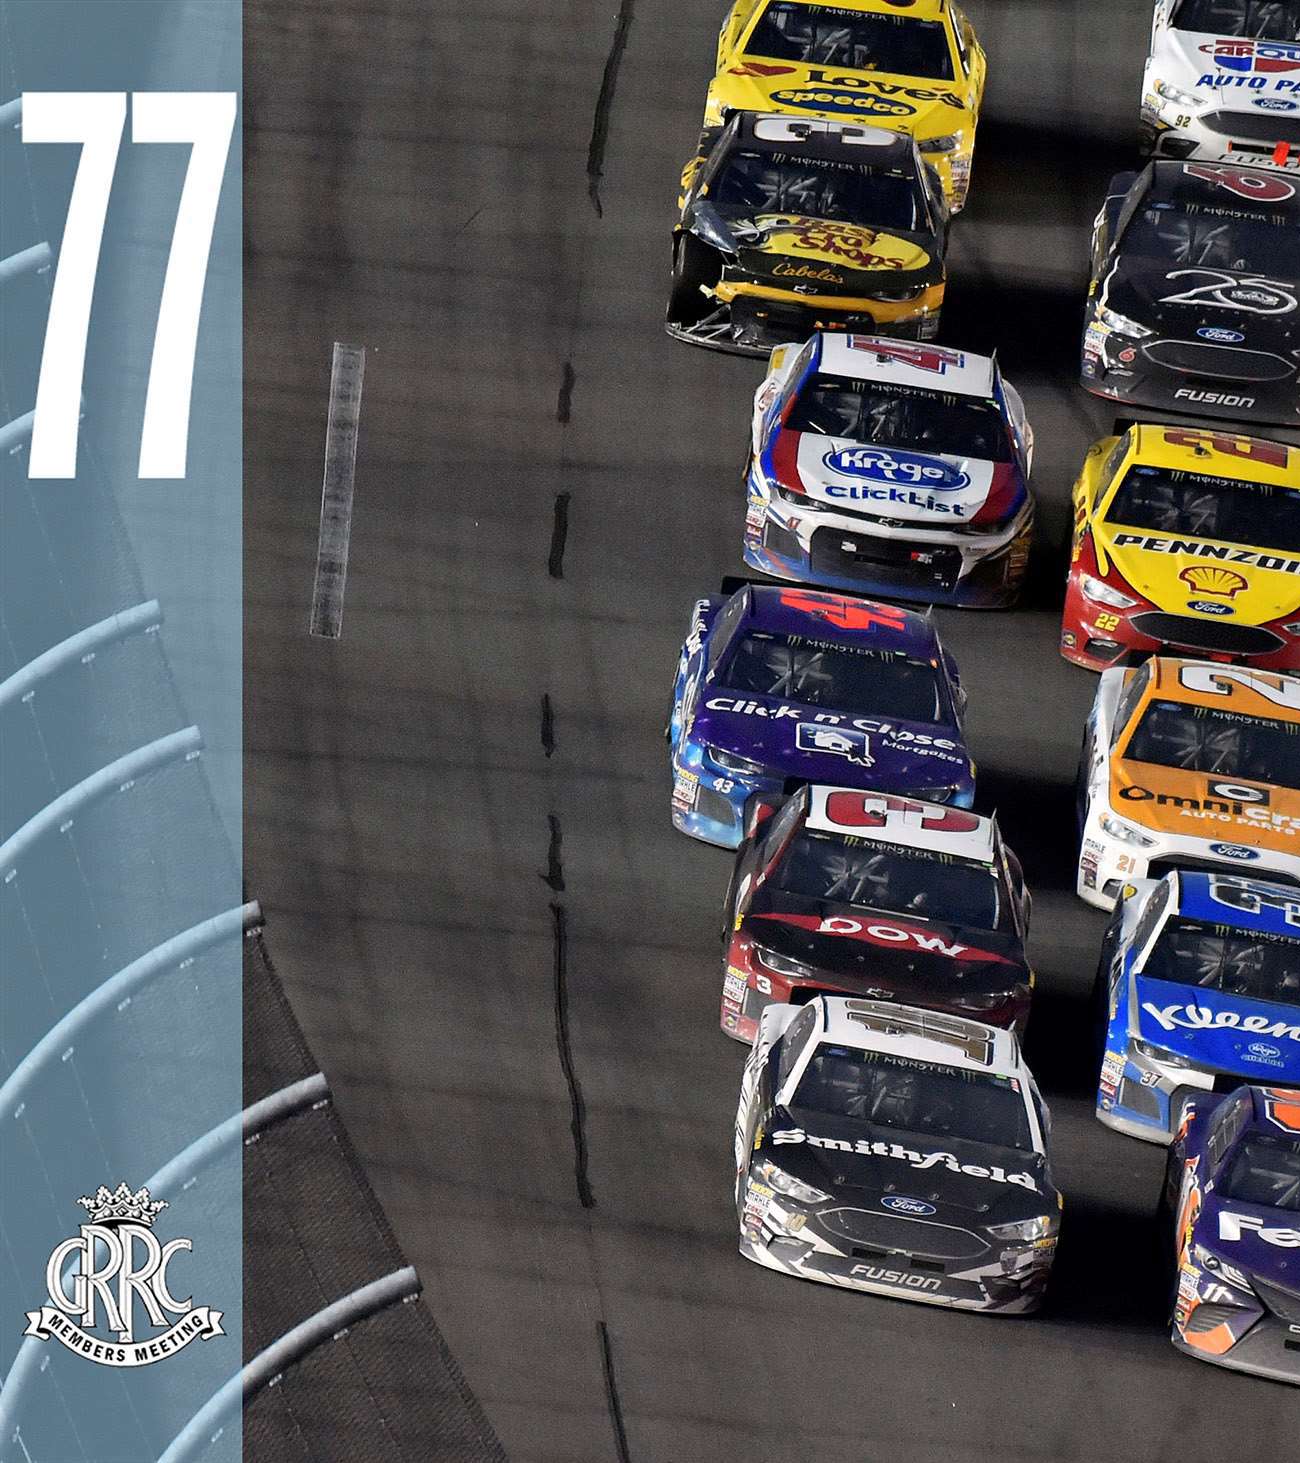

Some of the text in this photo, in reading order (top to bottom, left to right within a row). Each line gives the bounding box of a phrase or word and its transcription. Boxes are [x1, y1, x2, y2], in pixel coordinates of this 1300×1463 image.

[1195, 74, 1267, 89] AUTO
[1175, 114, 1191, 128] 92
[791, 156, 855, 170] MONSTER
[1203, 207, 1267, 221] MONSTER
[792, 234, 905, 270] Shops
[871, 383, 937, 400] MONSTER
[1174, 388, 1256, 408] FUSION
[1189, 473, 1254, 491] MONSTER
[1094, 613, 1120, 632] 22
[806, 638, 875, 657] MONSTER
[705, 697, 802, 719] Click
[853, 718, 957, 750] Close
[1212, 711, 1280, 729] MONSTER
[712, 778, 734, 794] 43
[1180, 809, 1296, 836] AUTO PARTS
[863, 839, 934, 861] MONSTER
[1116, 854, 1137, 874] 21
[816, 917, 968, 957] DOW
[756, 974, 772, 995] 3
[883, 1056, 956, 1076] MONSTER
[1141, 1071, 1163, 1088] 37
[772, 1128, 1042, 1195] Smithfield
[850, 1263, 942, 1291] FUSION
